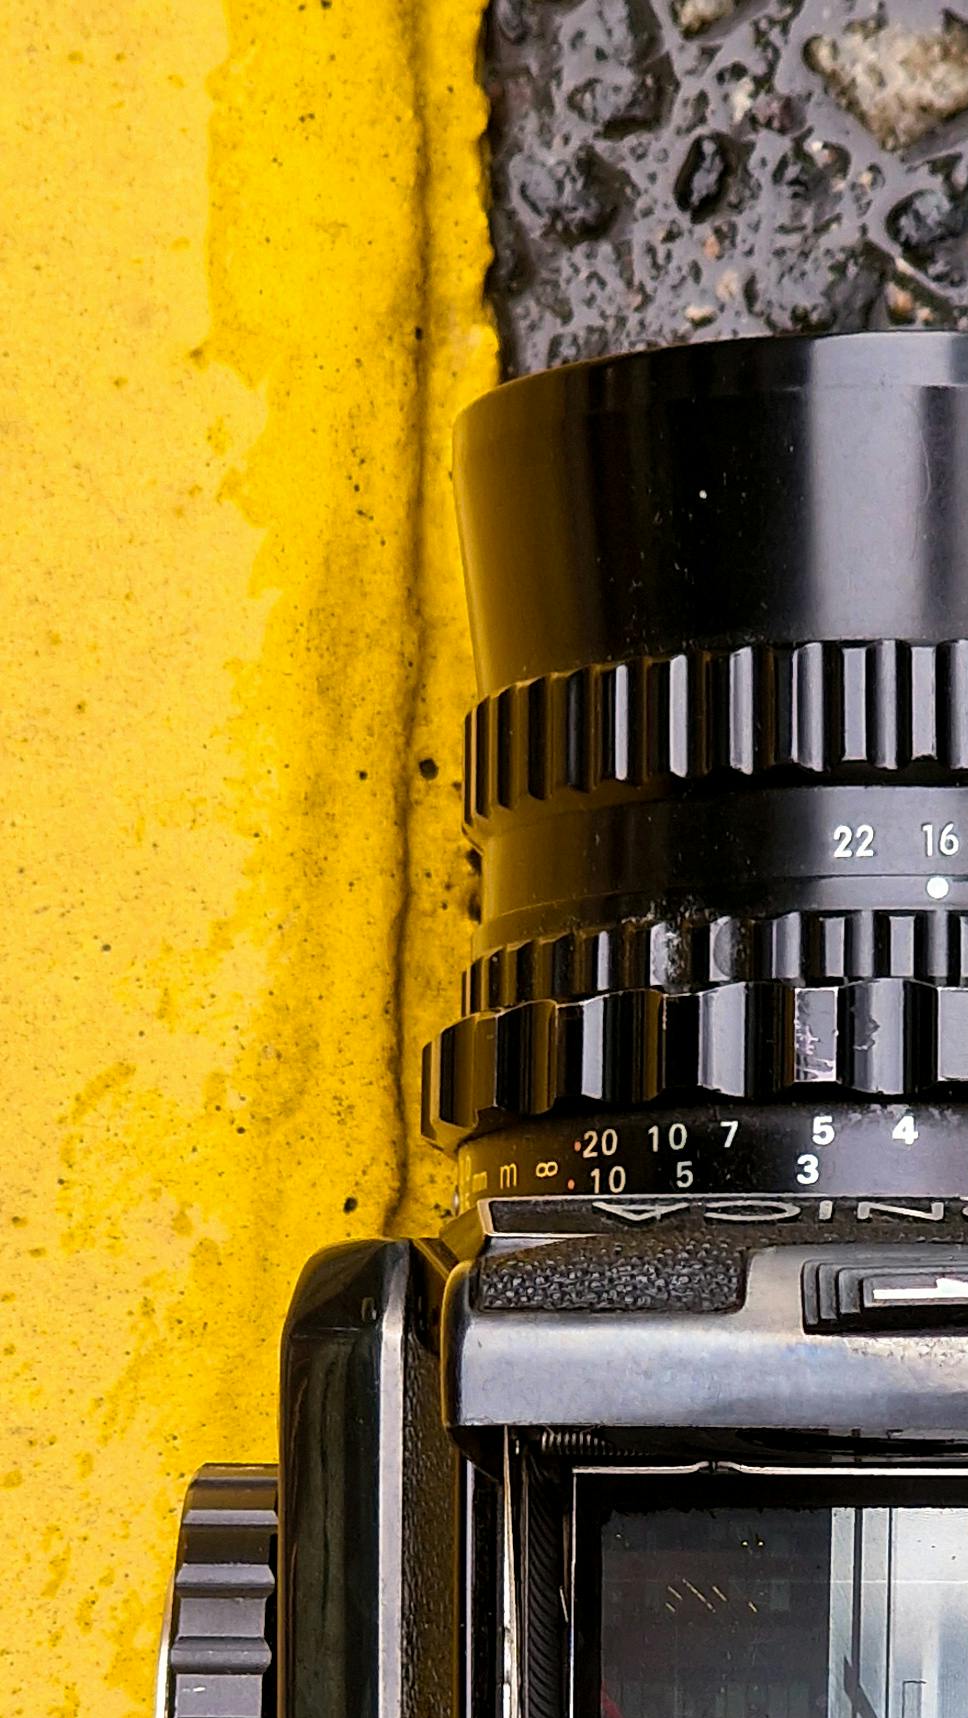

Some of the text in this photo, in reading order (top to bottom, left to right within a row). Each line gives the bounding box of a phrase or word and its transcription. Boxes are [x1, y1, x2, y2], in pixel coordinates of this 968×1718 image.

[832, 824, 875, 858] 22
[921, 823, 960, 857] 16
[582, 1128, 618, 1159] 20
[648, 1123, 688, 1152] 10
[720, 1120, 739, 1149] 7
[812, 1115, 836, 1146] 5
[891, 1115, 919, 1145] 4
[590, 1165, 626, 1194] 10
[676, 1160, 694, 1189] 5
[796, 1153, 821, 1185] 3
